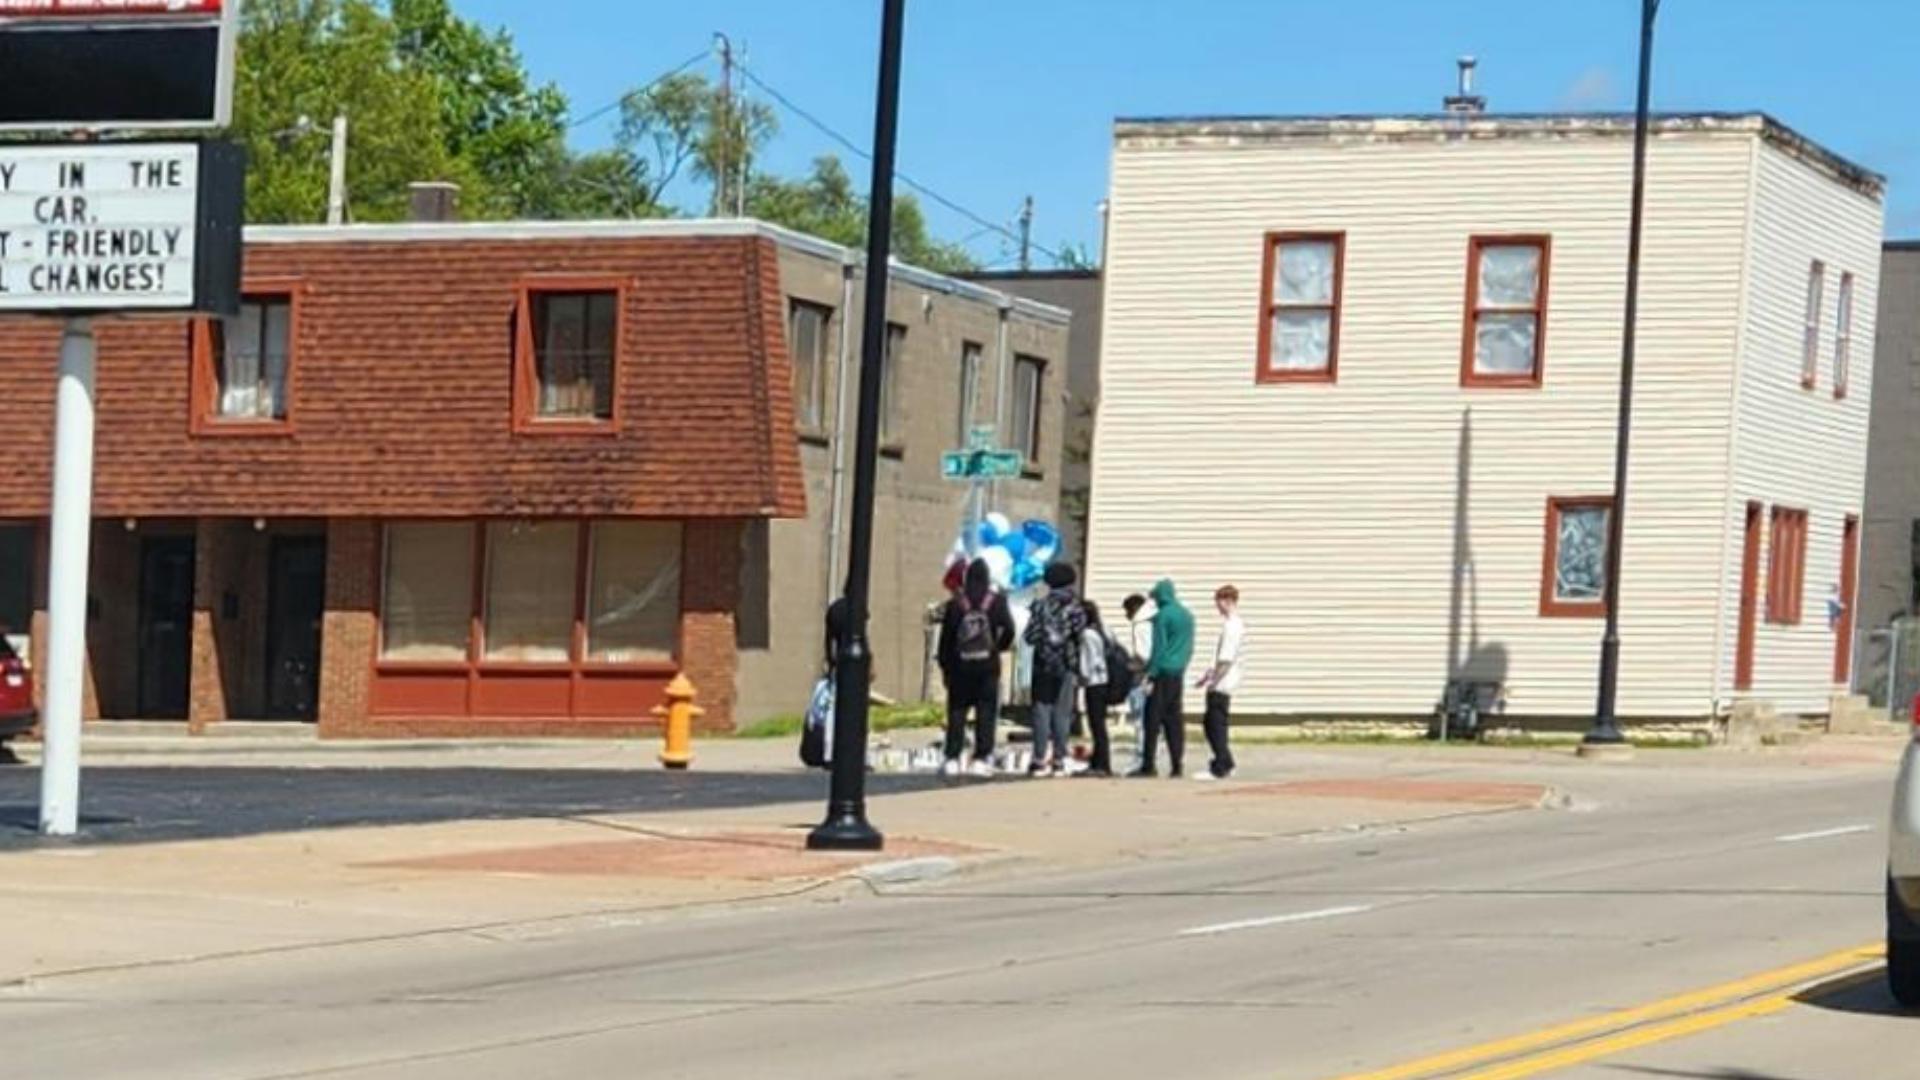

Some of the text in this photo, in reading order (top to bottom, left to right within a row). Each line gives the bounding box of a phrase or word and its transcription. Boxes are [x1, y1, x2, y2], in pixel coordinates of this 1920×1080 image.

[59, 162, 84, 188] IN
[130, 160, 182, 187] THE
[34, 196, 98, 224] CAR.
[47, 227, 181, 257] FRIENDLY
[30, 264, 165, 292] CHANGES!
